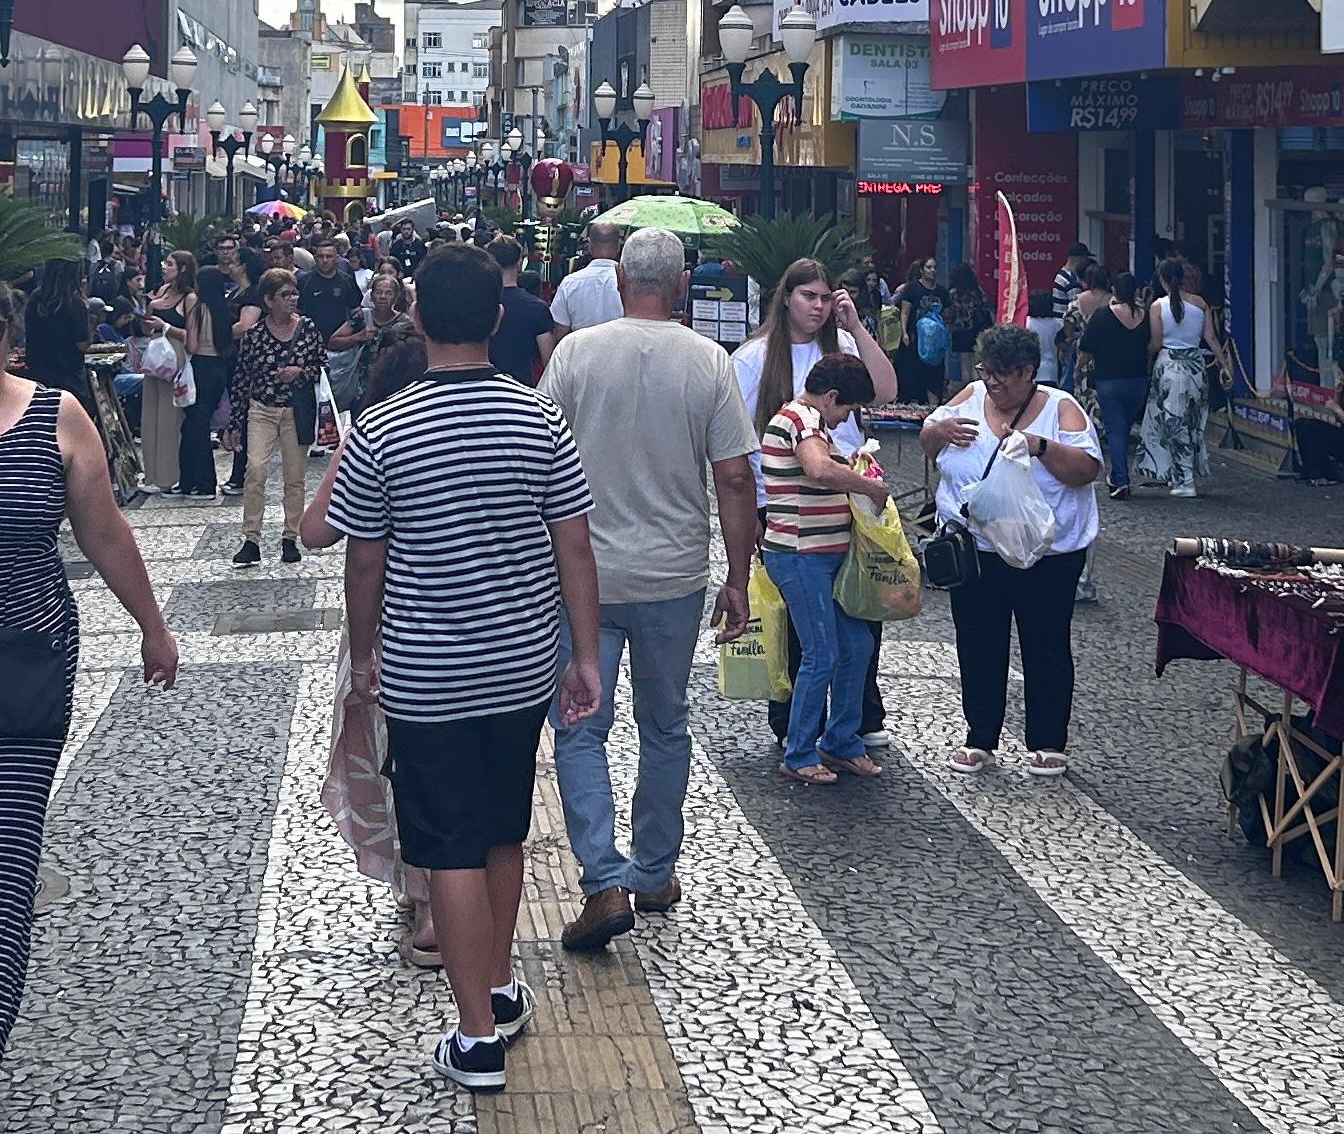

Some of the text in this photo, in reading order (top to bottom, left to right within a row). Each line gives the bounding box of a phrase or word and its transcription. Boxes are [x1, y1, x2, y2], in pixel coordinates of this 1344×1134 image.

[850, 42, 931, 58] DENTIST
[1080, 80, 1132, 93] PREÇO
[1070, 92, 1138, 107] MÁXIMO
[1070, 106, 1138, 129] R$14,99
